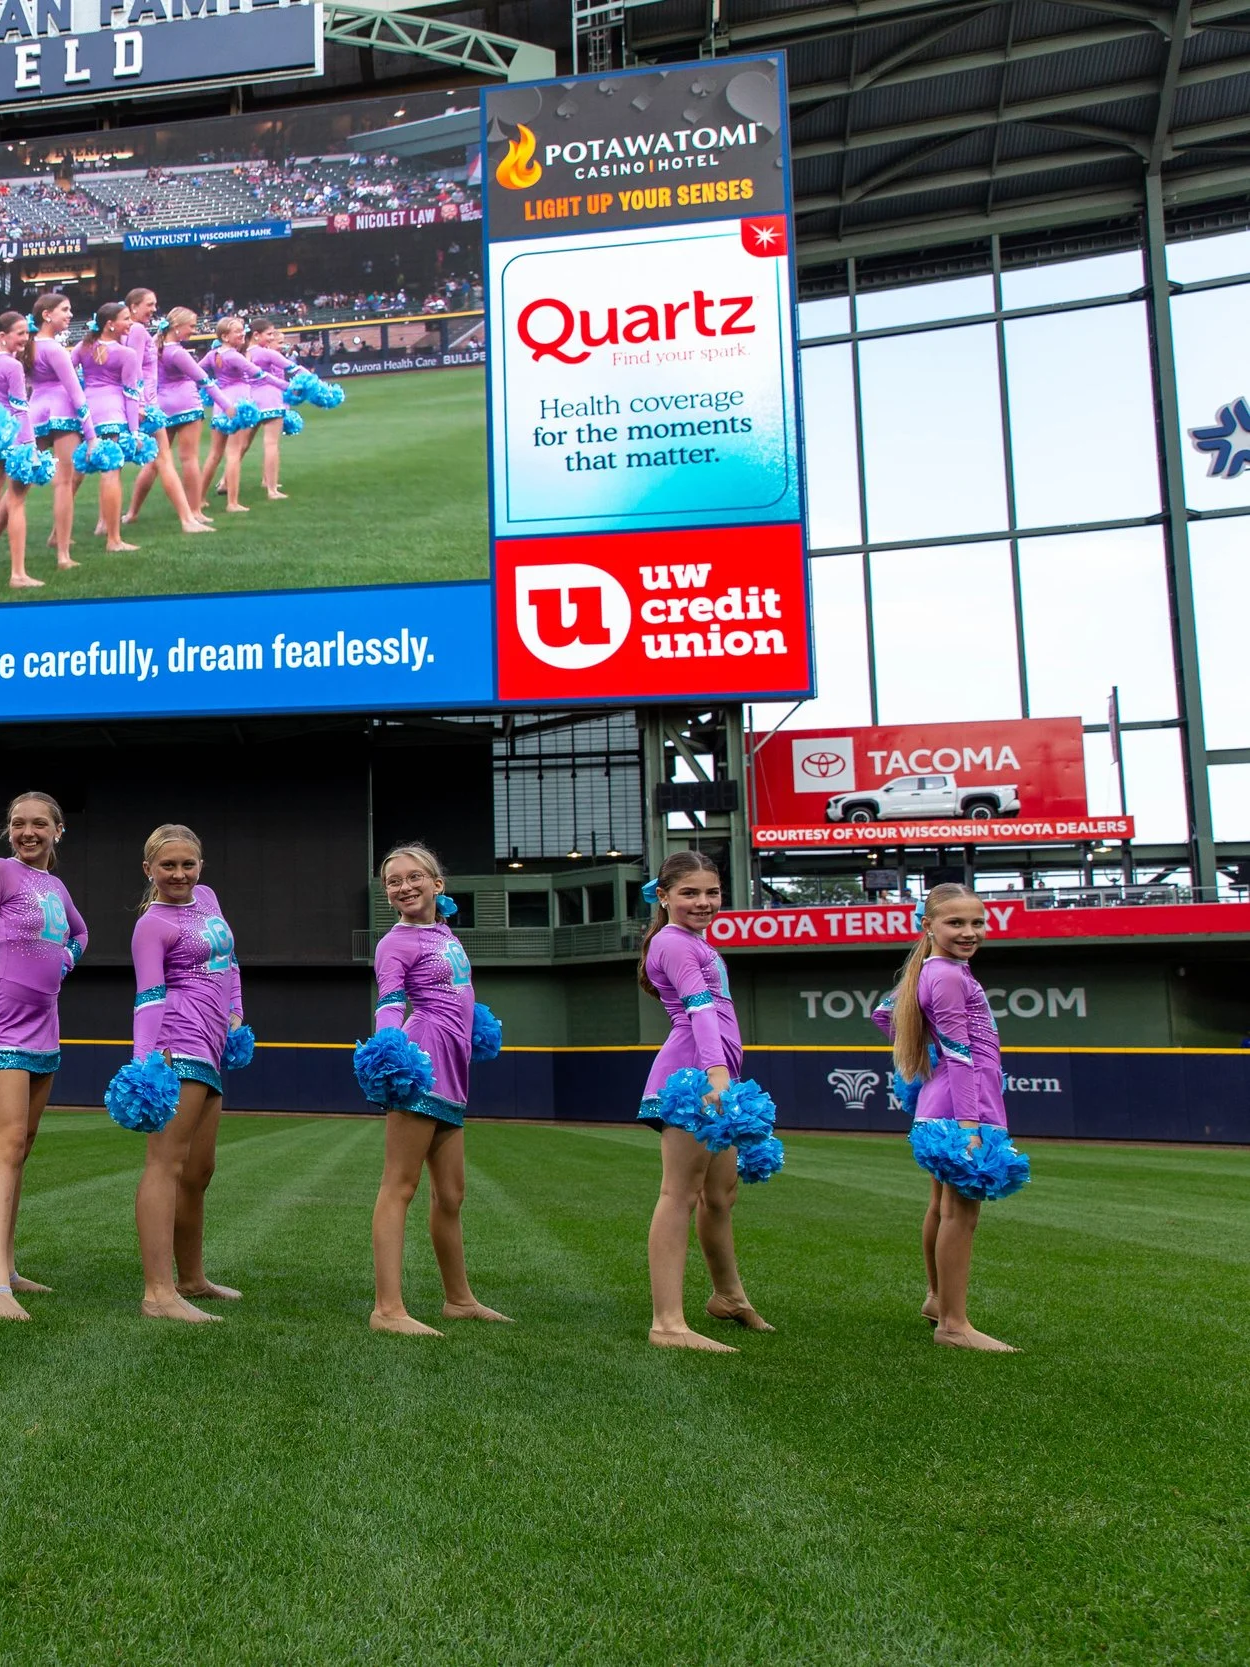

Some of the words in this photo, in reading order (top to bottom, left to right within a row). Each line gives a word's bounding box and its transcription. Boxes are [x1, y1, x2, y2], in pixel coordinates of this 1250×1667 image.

[546, 122, 759, 165] POTAWATOMI
[575, 161, 644, 180] CASINO
[658, 153, 719, 171] HOTEL
[524, 195, 582, 221] LIGHT
[586, 192, 614, 214] UP
[619, 187, 672, 211] YOUR
[677, 178, 754, 206] SENSES
[356, 211, 406, 230] NICOLET
[410, 208, 436, 224] LAW
[22, 244, 81, 257] BREWERS
[23, 241, 46, 249] HOME
[128, 232, 191, 247] WINTRUST
[199, 229, 249, 241] WISCONSIN'S
[251, 228, 271, 237] BANK
[517, 290, 756, 364] Quartz
[352, 362, 381, 373] Aurora
[384, 359, 413, 371] Health
[415, 357, 437, 368] Care
[612, 349, 650, 366] Find
[656, 349, 694, 366] your
[540, 394, 620, 419] Health
[629, 389, 744, 413] coverage
[533, 426, 568, 447] for
[576, 422, 618, 444] the
[627, 415, 753, 441] moments
[564, 450, 618, 472] that
[626, 445, 720, 469] matter.
[639, 563, 712, 590] uw
[640, 586, 783, 624] credit
[23, 638, 159, 683] carefully,
[168, 637, 264, 674] dream
[272, 627, 436, 672] fearlessly.
[641, 624, 788, 659] union
[867, 745, 1021, 776] TACOMA
[756, 827, 831, 842] COURTESY
[834, 827, 853, 840] OF
[855, 825, 897, 840] YOUR
[898, 823, 990, 838] WISCONSIN
[991, 822, 1051, 836] TOYOTA
[1055, 820, 1128, 835] DEALERS
[703, 912, 816, 940] OYOTA
